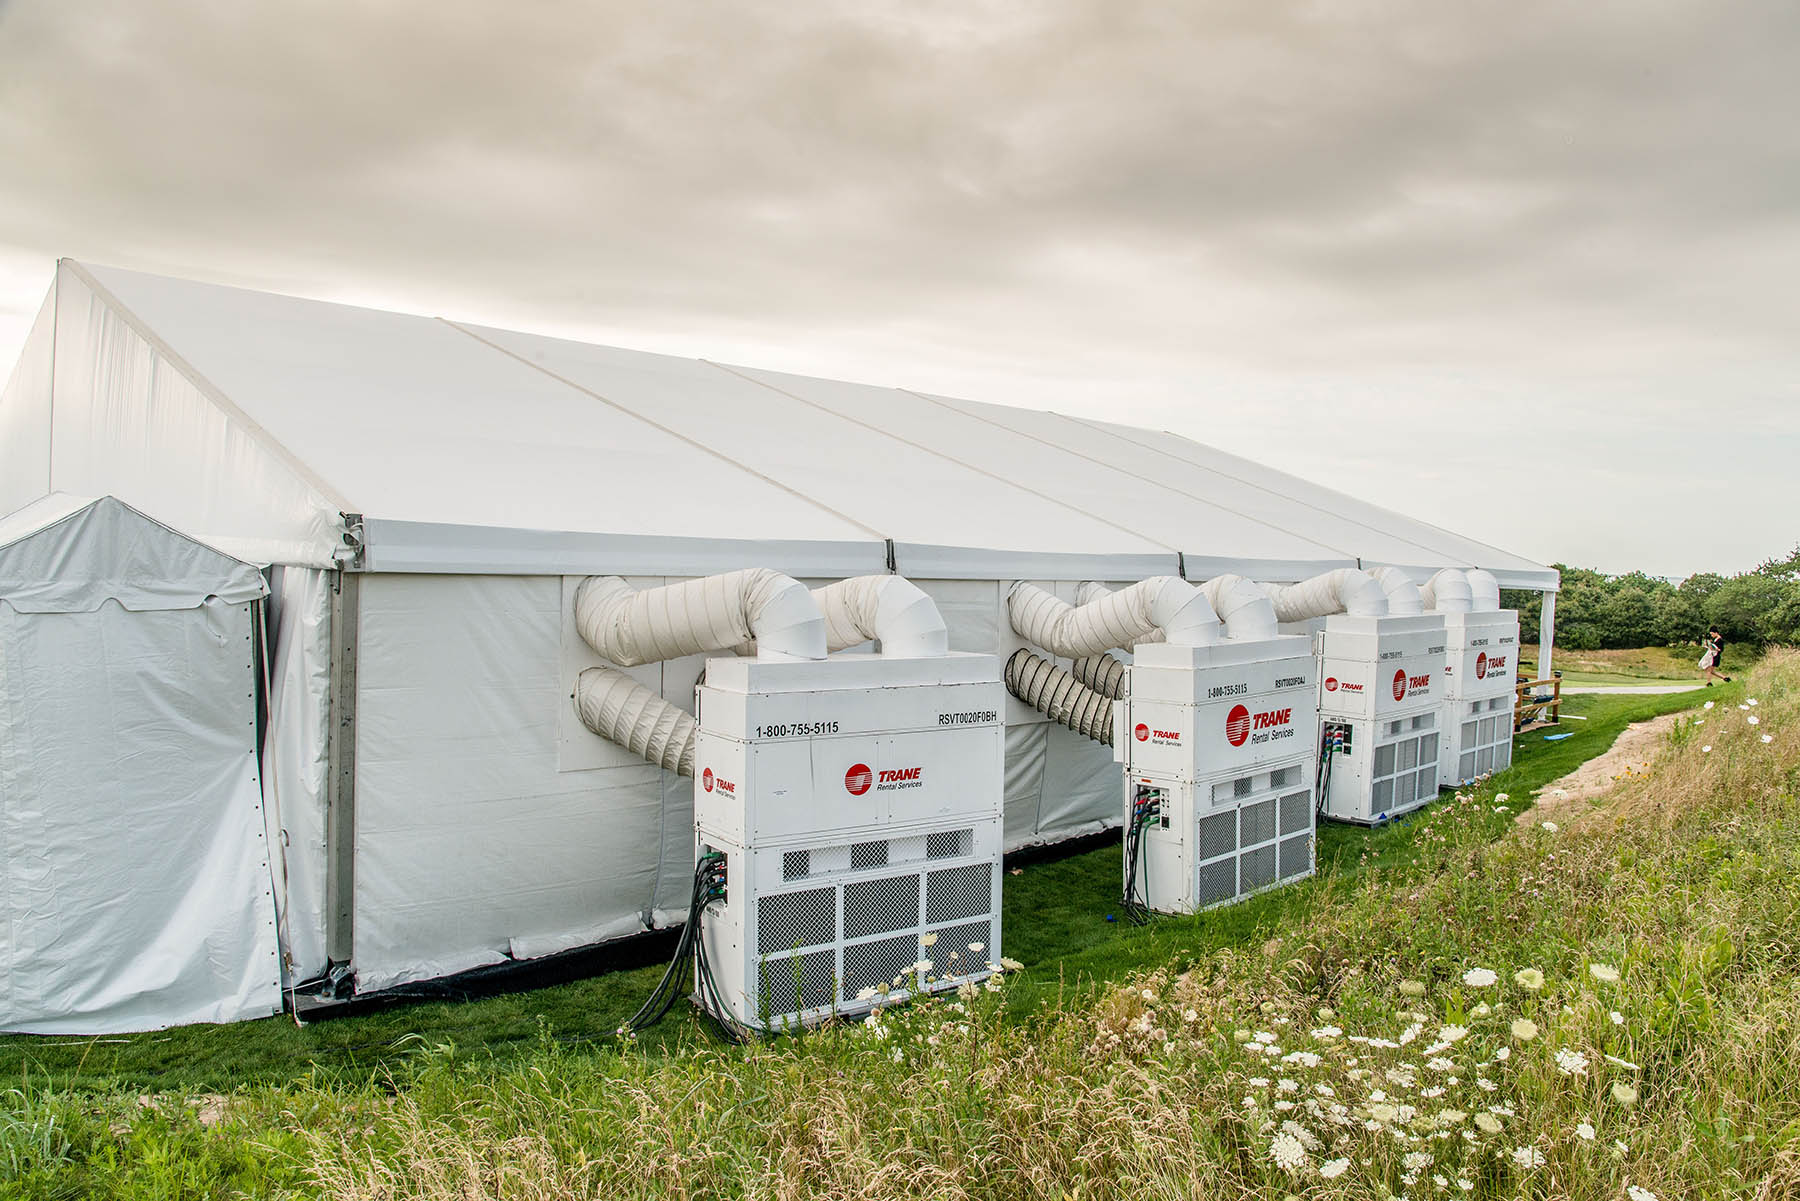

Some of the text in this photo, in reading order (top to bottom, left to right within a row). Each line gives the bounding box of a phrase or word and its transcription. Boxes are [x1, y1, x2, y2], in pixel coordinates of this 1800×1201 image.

[1341, 682, 1364, 691] TRANE
[1409, 674, 1430, 689] TRANE
[1207, 683, 1248, 699] 1-800-755-5115
[1253, 708, 1292, 730] TRANE
[755, 721, 839, 738] 1-800-755-5115
[1152, 730, 1181, 740] TRANE
[1251, 728, 1295, 745] Rental Services
[878, 767, 922, 783] TRANE
[716, 778, 736, 793] TRANE
[877, 780, 923, 791] Rental Services
